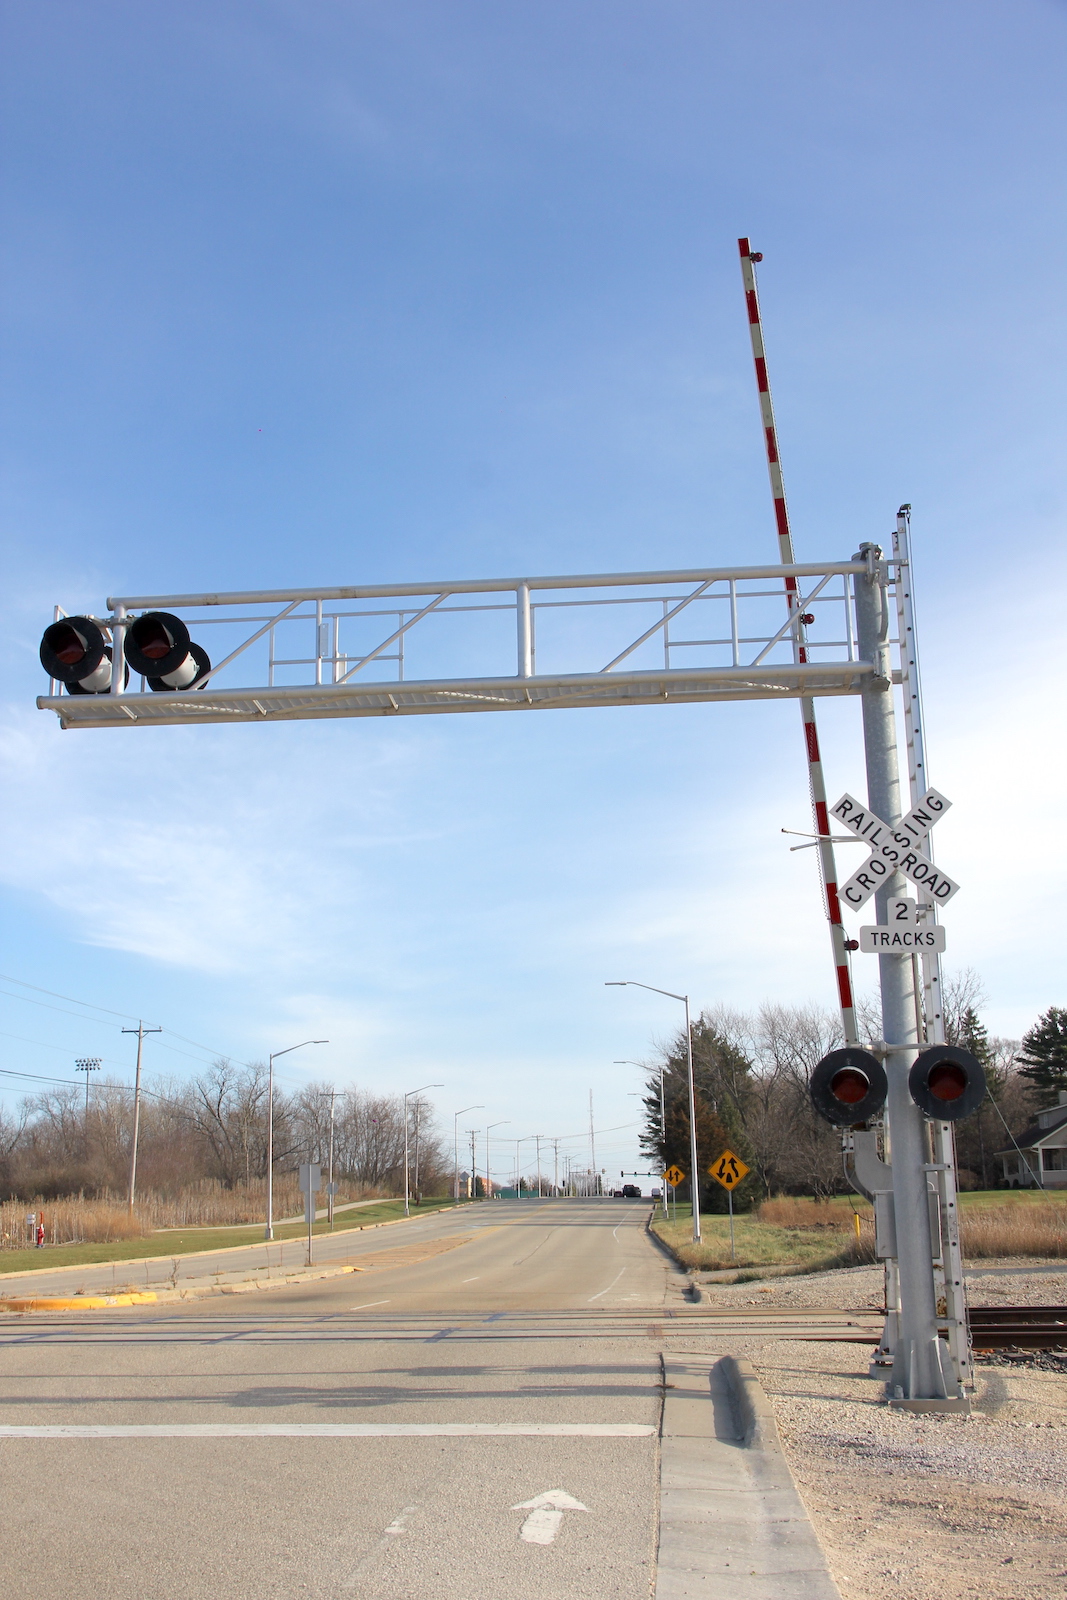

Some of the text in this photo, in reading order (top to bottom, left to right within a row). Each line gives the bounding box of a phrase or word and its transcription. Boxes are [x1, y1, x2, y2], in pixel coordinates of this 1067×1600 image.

[835, 799, 952, 898] RAIL ROAD
[845, 796, 943, 903] CROSSING
[871, 932, 935, 946] TRACKS
[895, 903, 909, 920] 2
